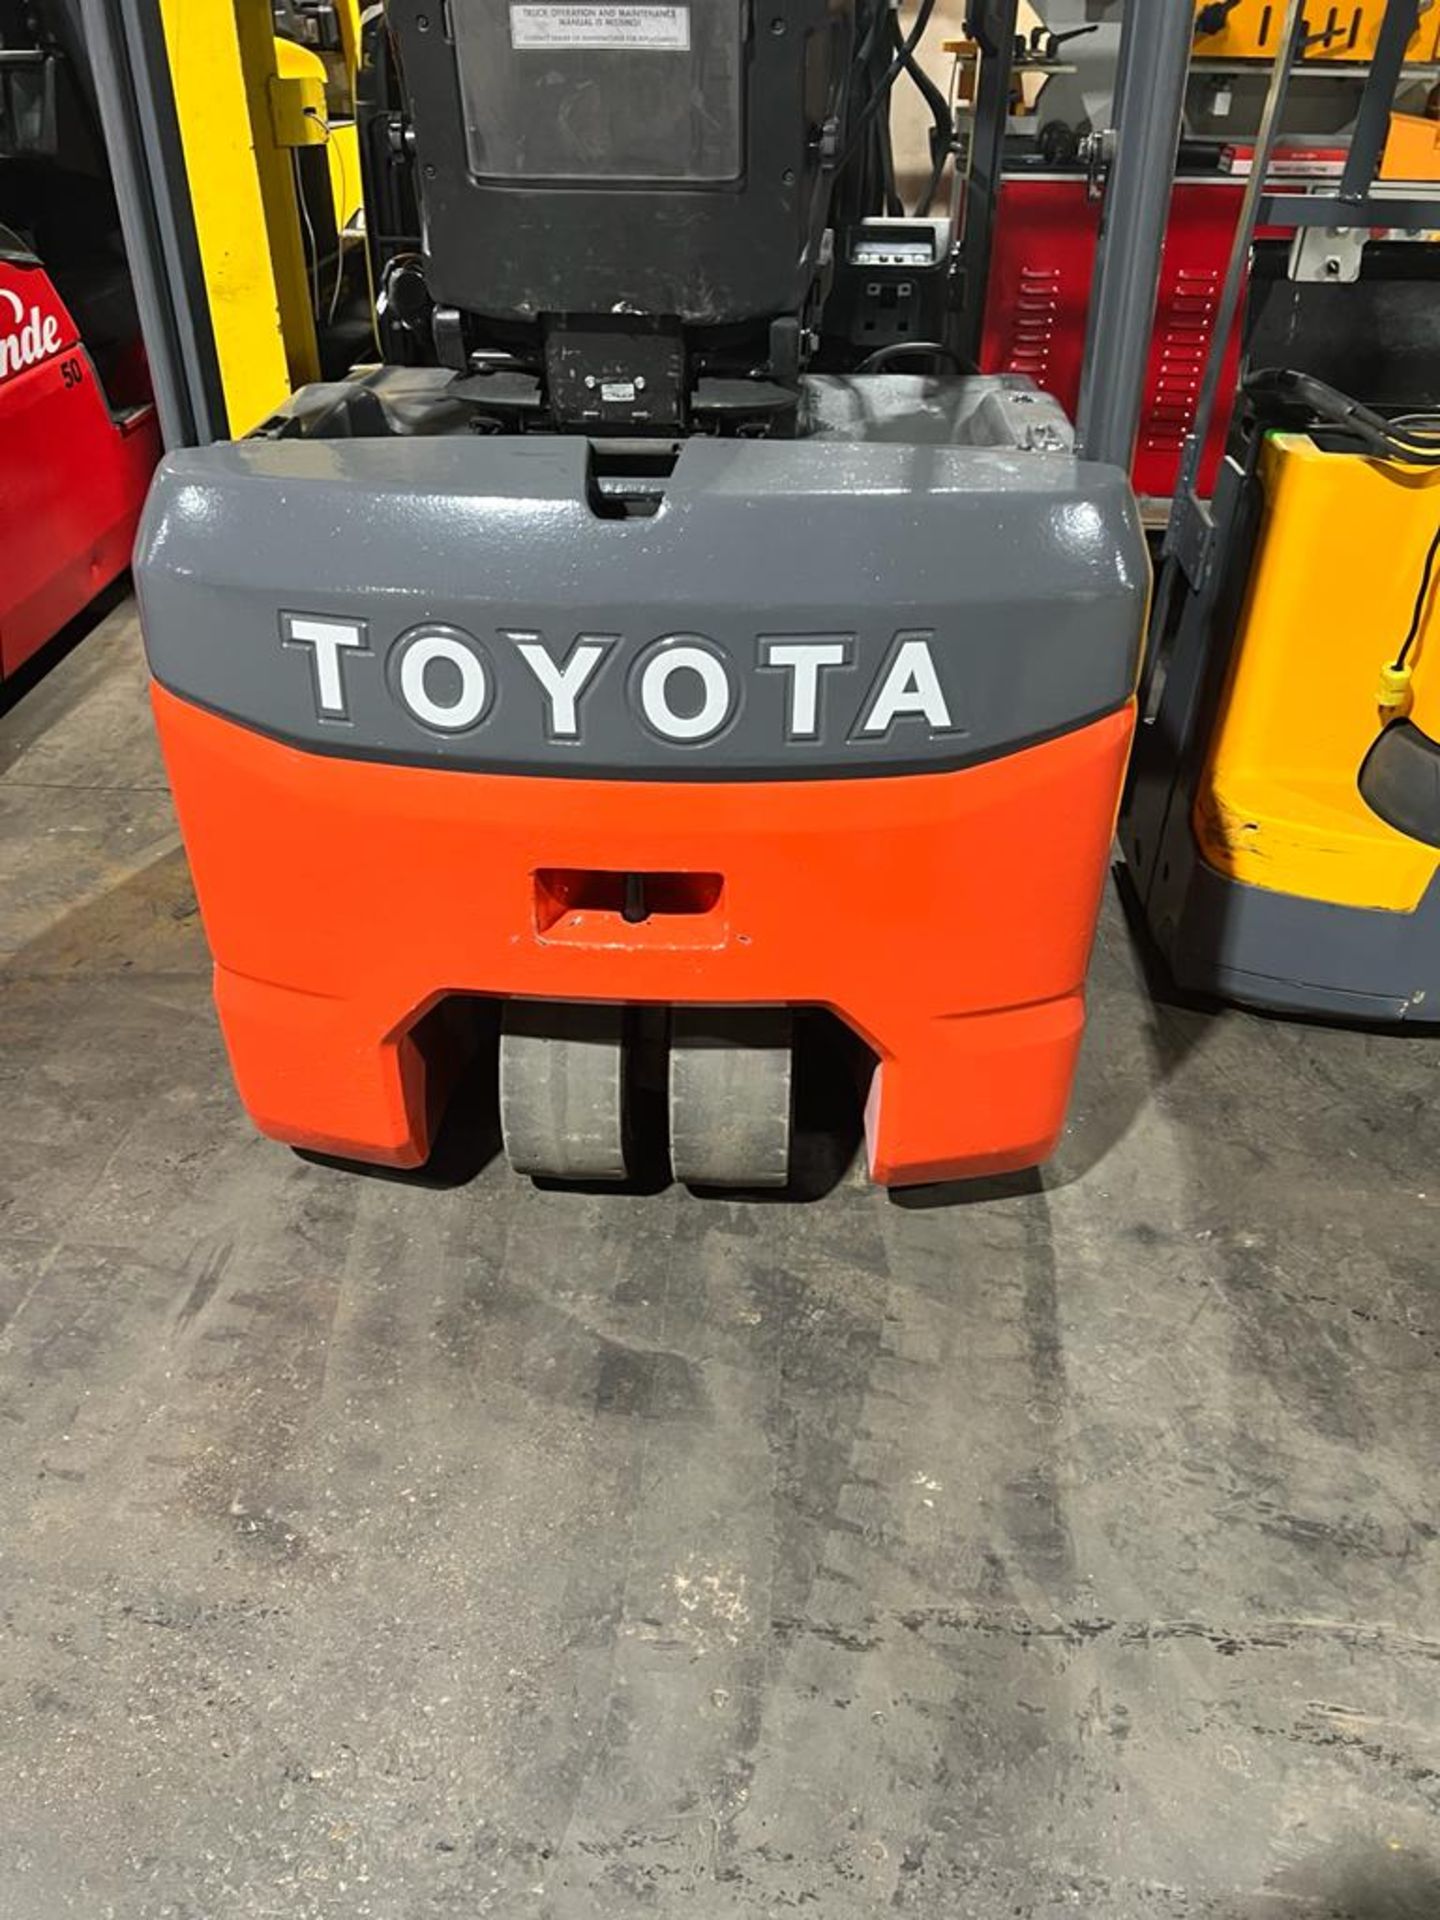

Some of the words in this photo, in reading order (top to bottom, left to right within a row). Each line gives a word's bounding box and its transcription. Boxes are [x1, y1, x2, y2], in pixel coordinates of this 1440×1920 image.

[523, 8, 547, 17] TRUCK
[551, 8, 596, 18] OPERATION
[599, 9, 616, 17] AND
[618, 9, 676, 18] MAINTENANCE
[559, 18, 593, 26] MANUAL
[595, 18, 603, 26] IS
[0, 288, 62, 378] nde
[60, 357, 83, 388] 50
[292, 621, 950, 737] TOYOTA
